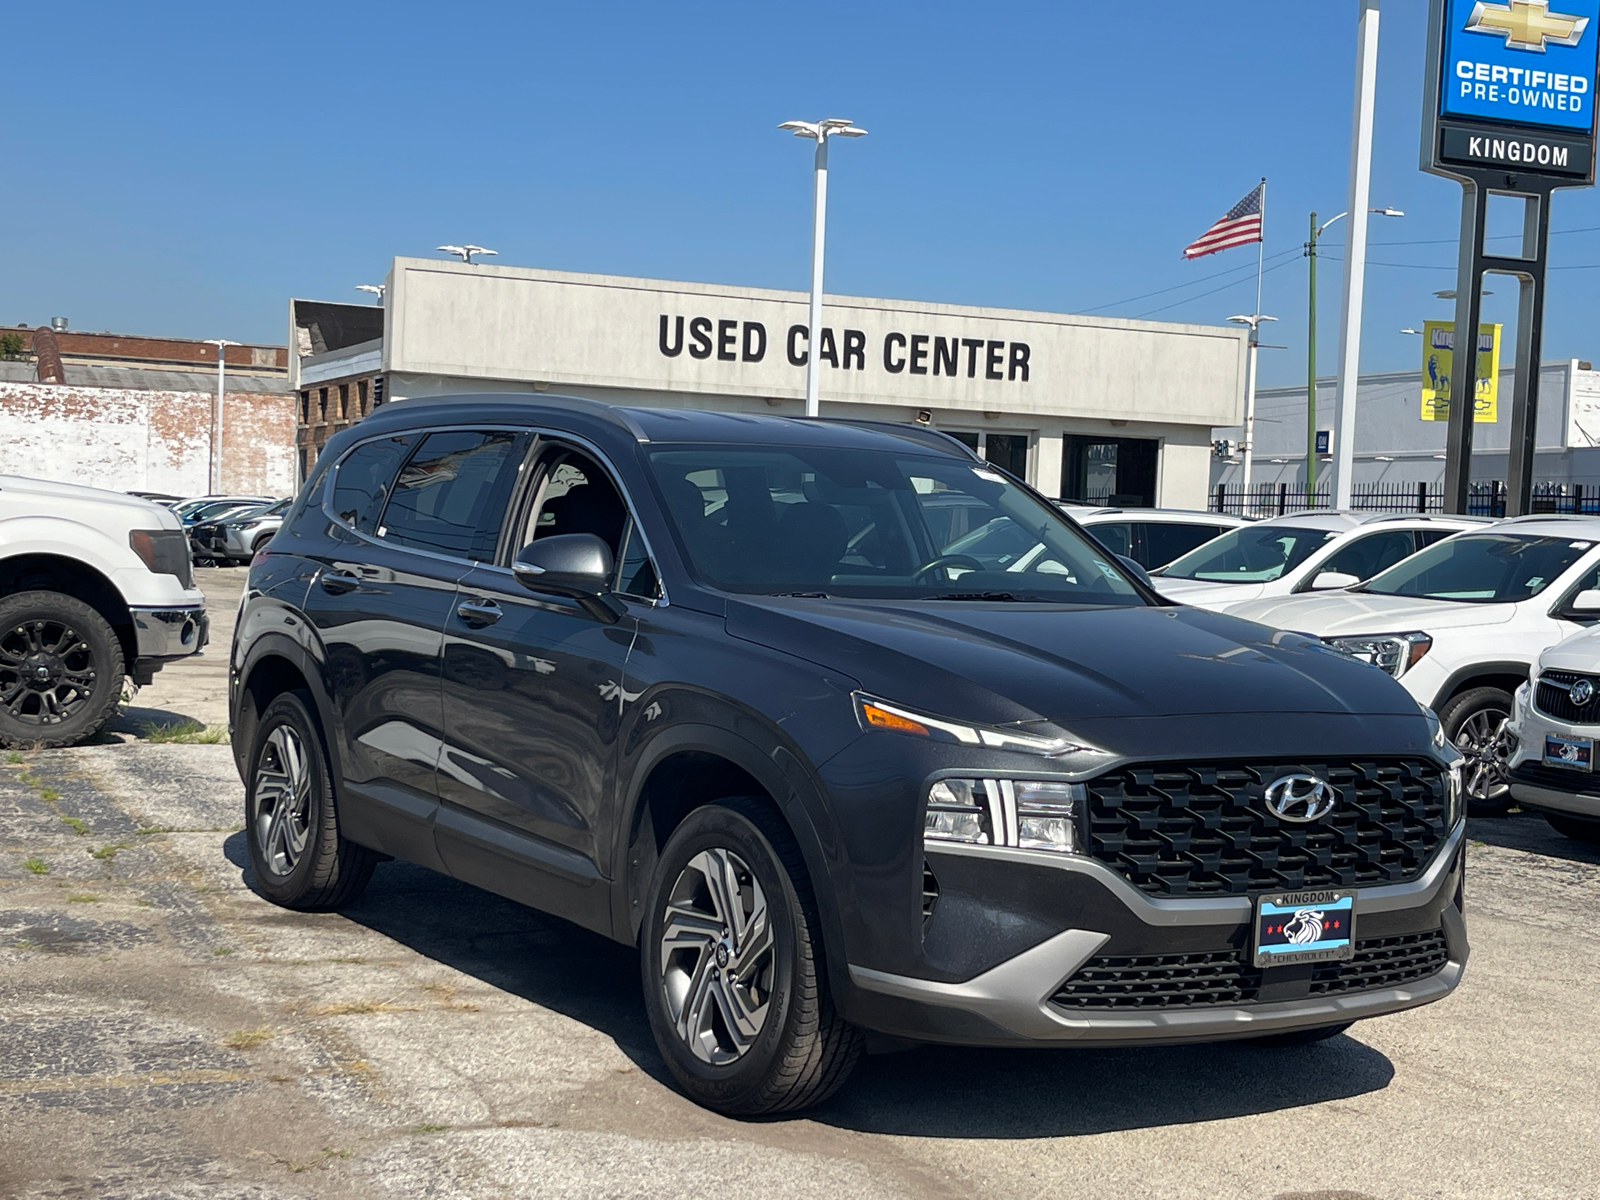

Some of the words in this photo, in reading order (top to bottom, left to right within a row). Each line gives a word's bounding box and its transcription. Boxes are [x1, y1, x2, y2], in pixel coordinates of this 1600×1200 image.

[1456, 60, 1588, 94] CERTIFIED
[1460, 81, 1582, 112] PRE-OWNED
[1469, 136, 1568, 167] KINGDOM
[658, 314, 767, 363] USED
[786, 324, 866, 370] CAR
[883, 332, 1031, 382] CENTER
[1282, 891, 1334, 904] KINGDOM
[1277, 951, 1330, 963] CHEVROLET
